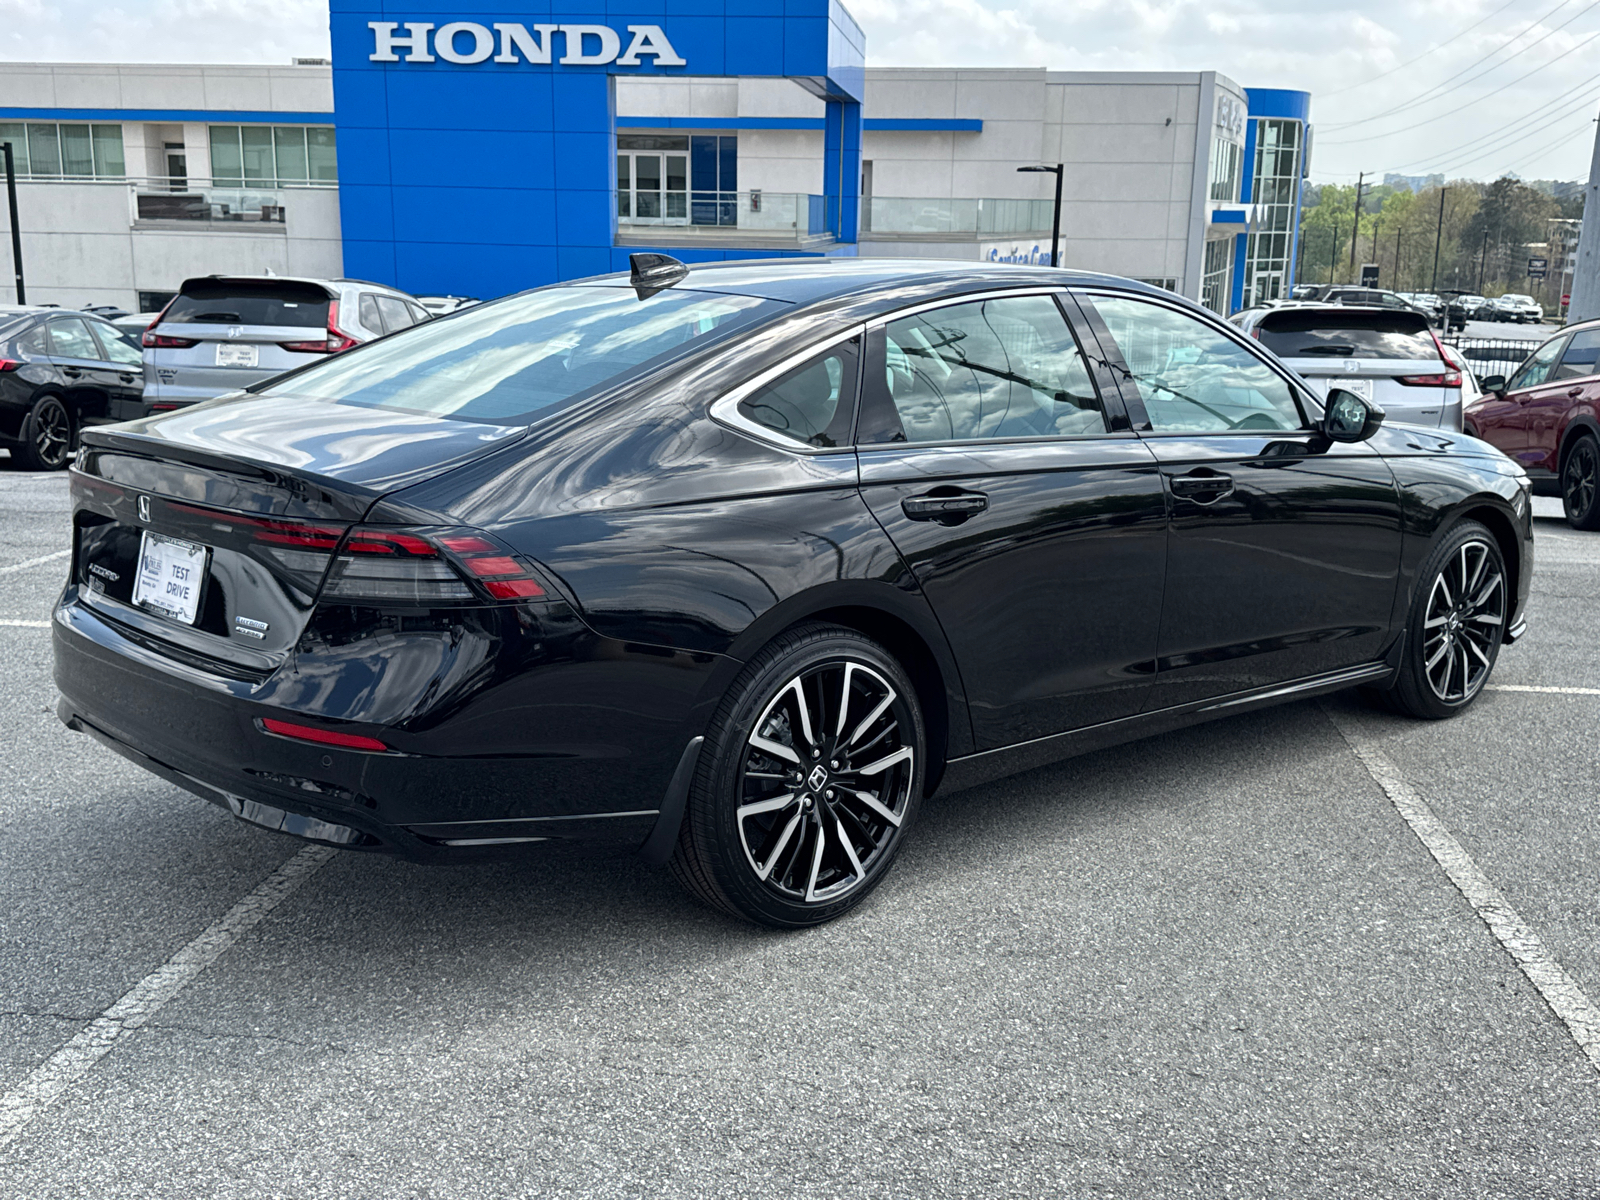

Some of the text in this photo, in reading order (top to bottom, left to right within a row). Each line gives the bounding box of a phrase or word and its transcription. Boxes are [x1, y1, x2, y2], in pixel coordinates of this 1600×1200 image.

[368, 21, 686, 66] HONDA
[172, 564, 190, 581] TEST
[166, 581, 190, 600] DRIVE
